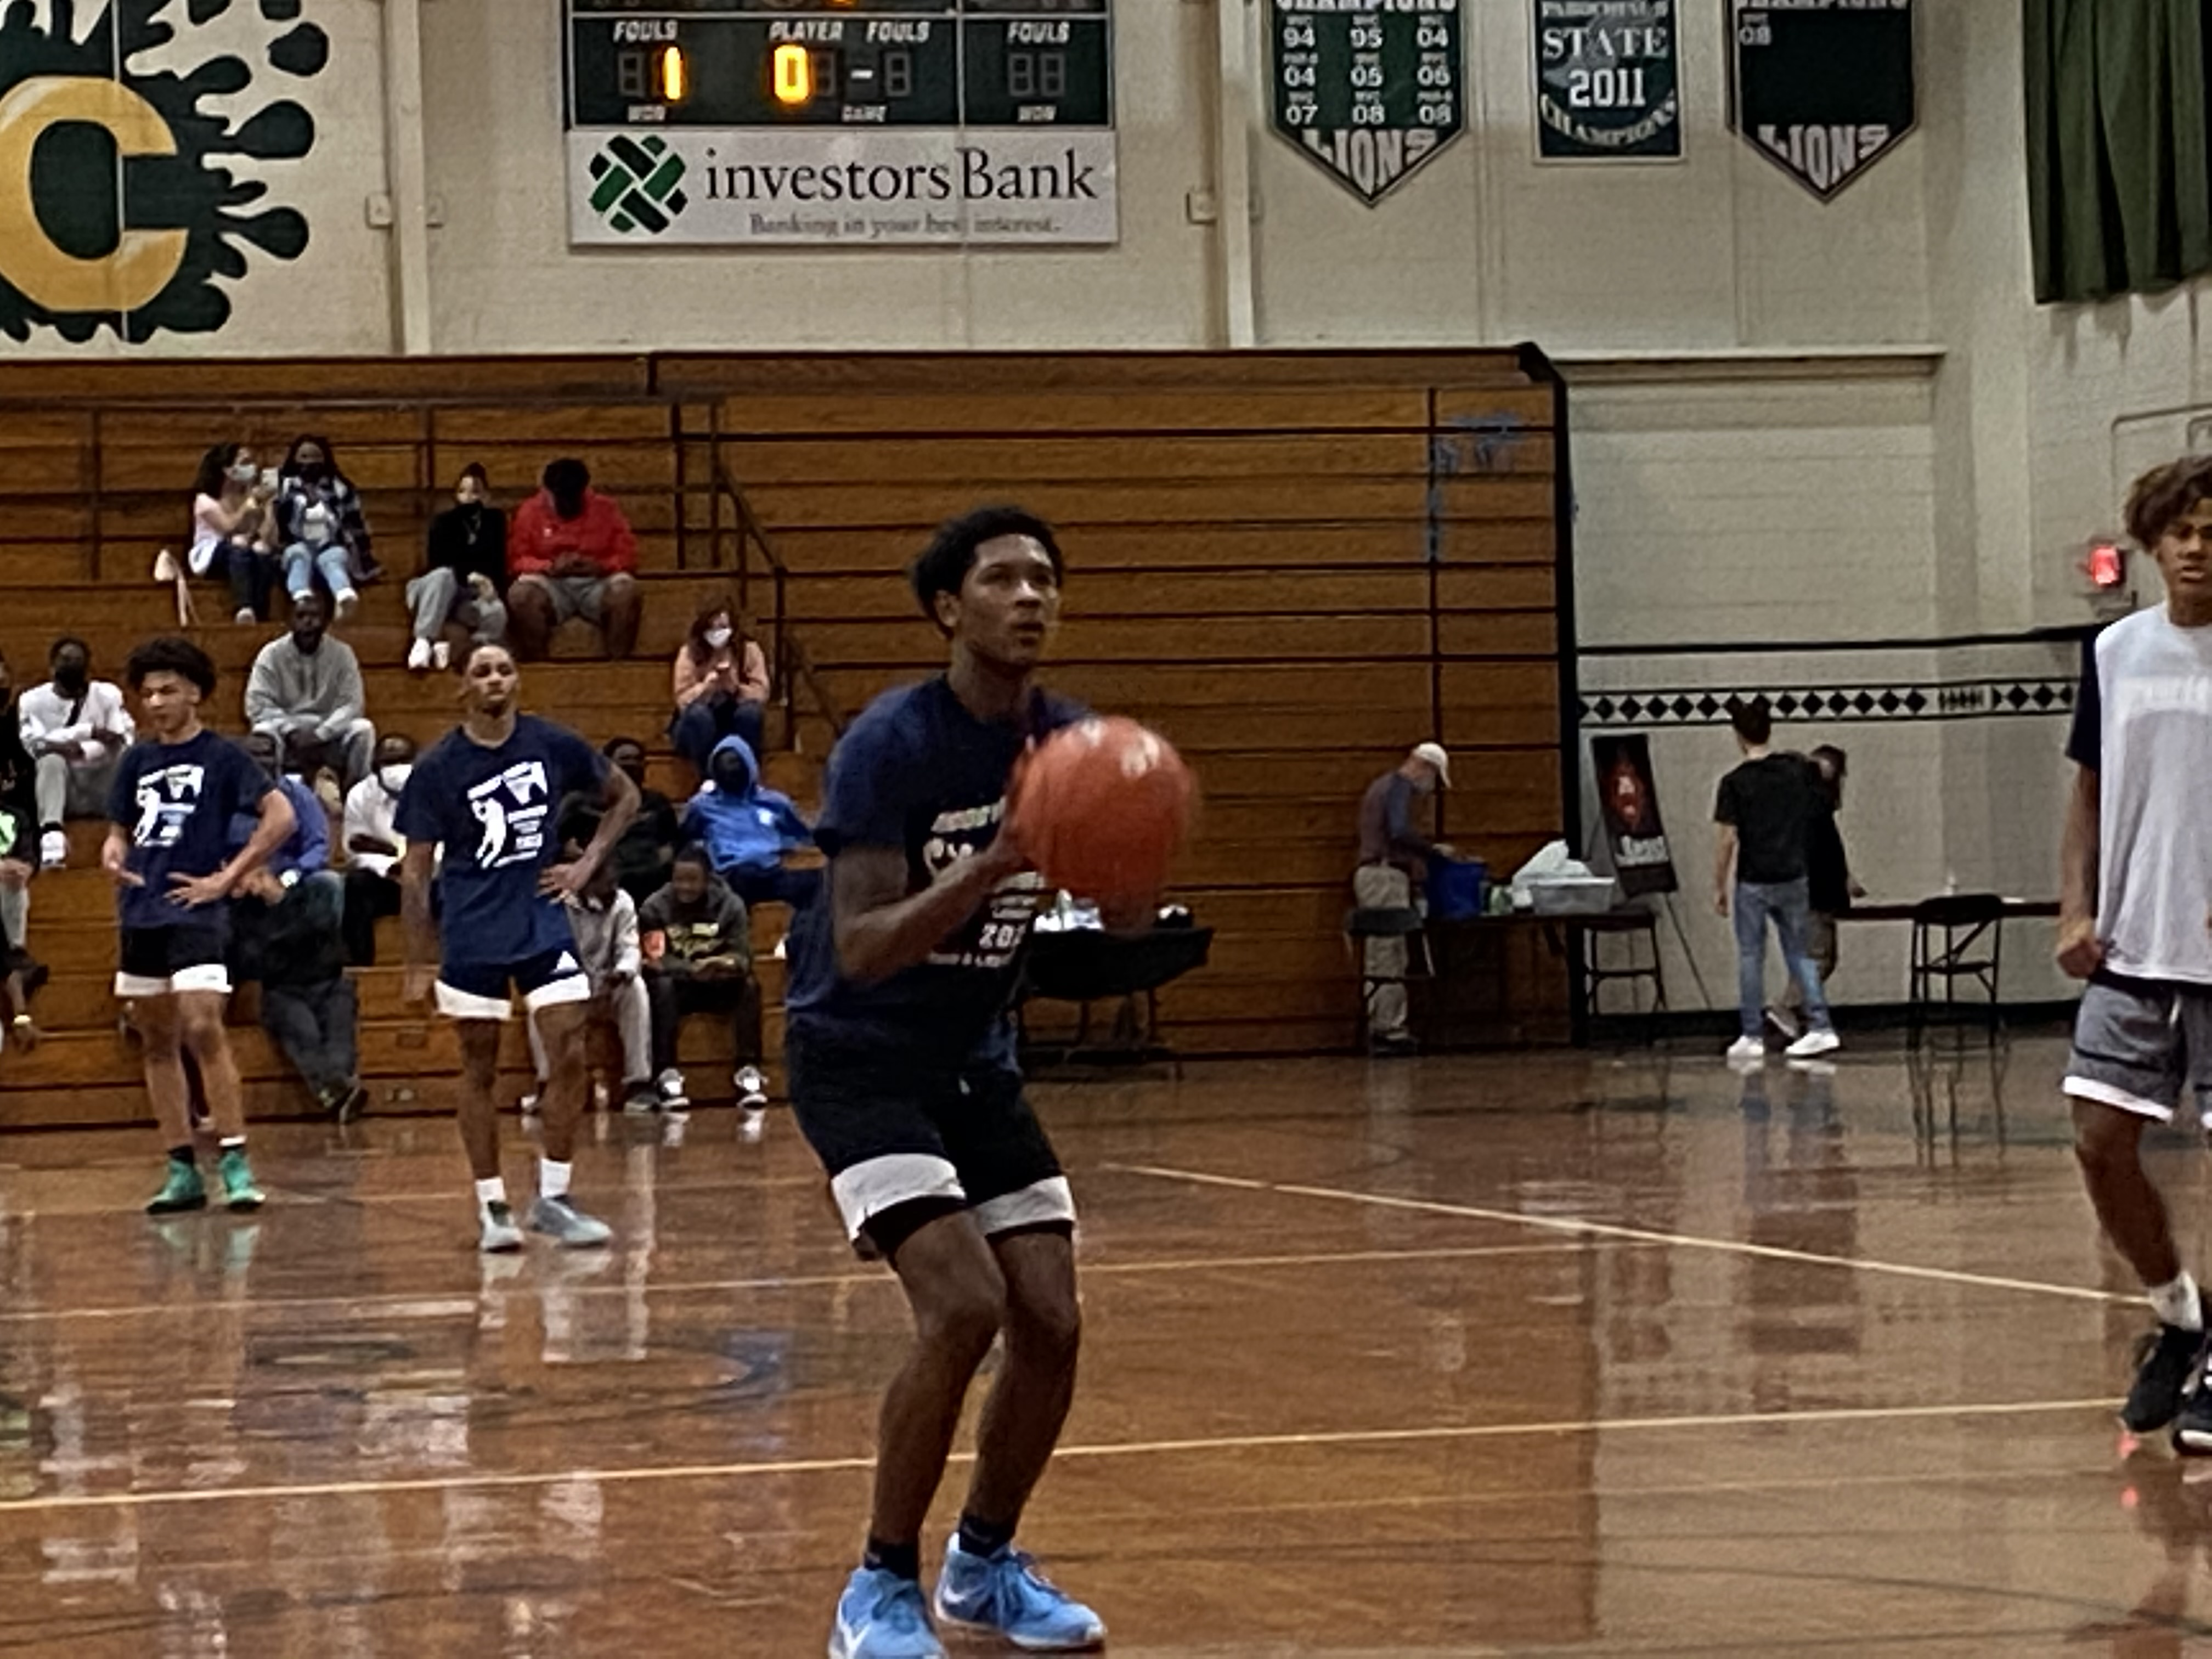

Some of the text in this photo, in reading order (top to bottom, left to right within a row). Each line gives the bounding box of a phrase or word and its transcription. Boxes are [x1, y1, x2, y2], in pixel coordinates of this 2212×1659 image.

[613, 20, 679, 43] FOULS
[769, 20, 931, 43] PLAYER FOULS
[1007, 20, 1070, 43] FOULS
[1416, 27, 1449, 48] 04
[1542, 27, 1668, 59] STATE
[1284, 64, 1316, 86] 04
[1568, 67, 1646, 107] 2011
[1286, 103, 1318, 125] 07
